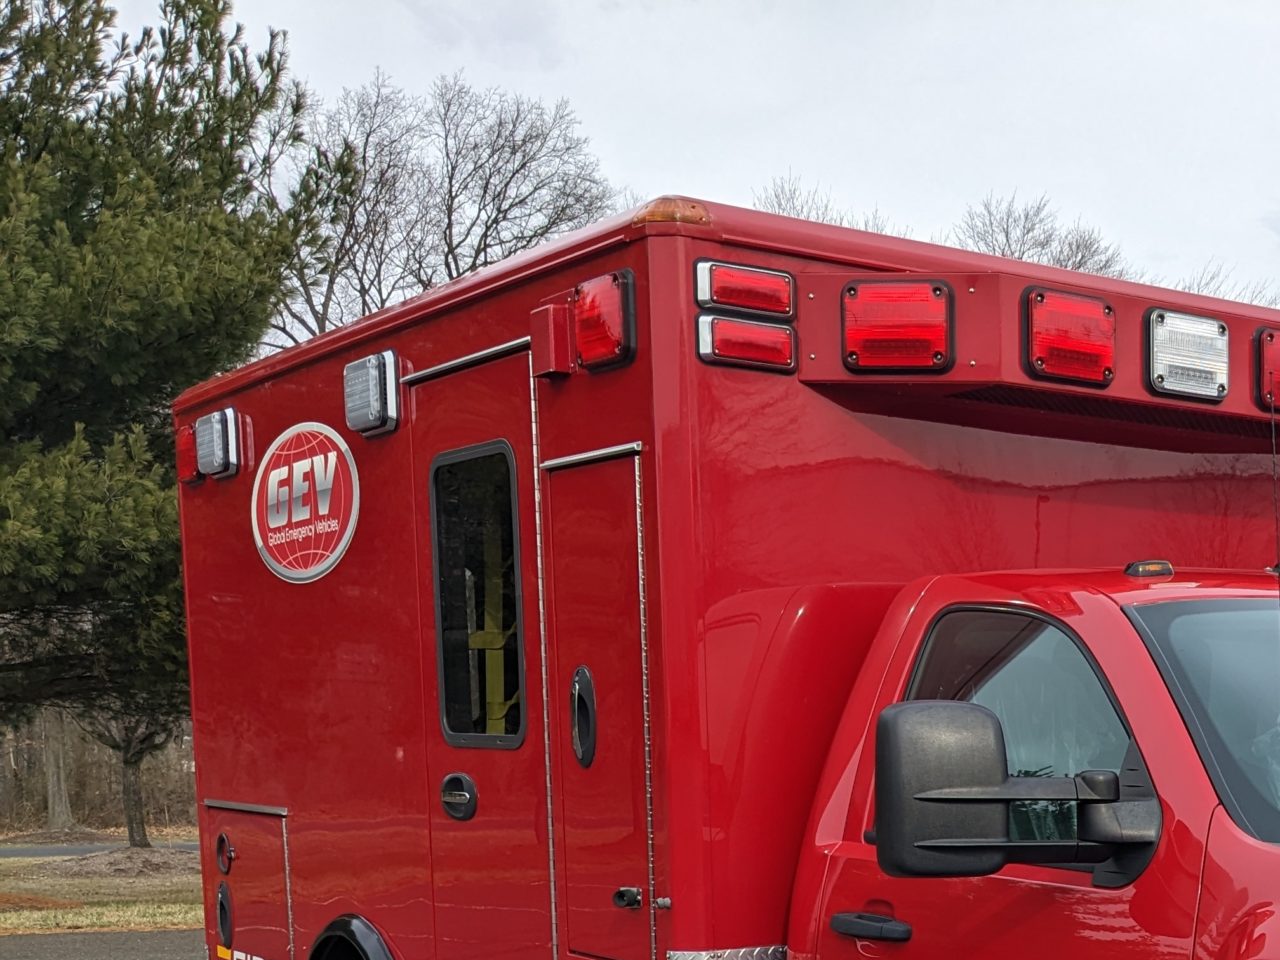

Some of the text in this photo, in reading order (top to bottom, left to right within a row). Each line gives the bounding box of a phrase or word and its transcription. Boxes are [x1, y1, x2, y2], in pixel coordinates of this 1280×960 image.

[267, 451, 337, 529] GEV
[268, 518, 338, 546] Global Emergency Vehicles
